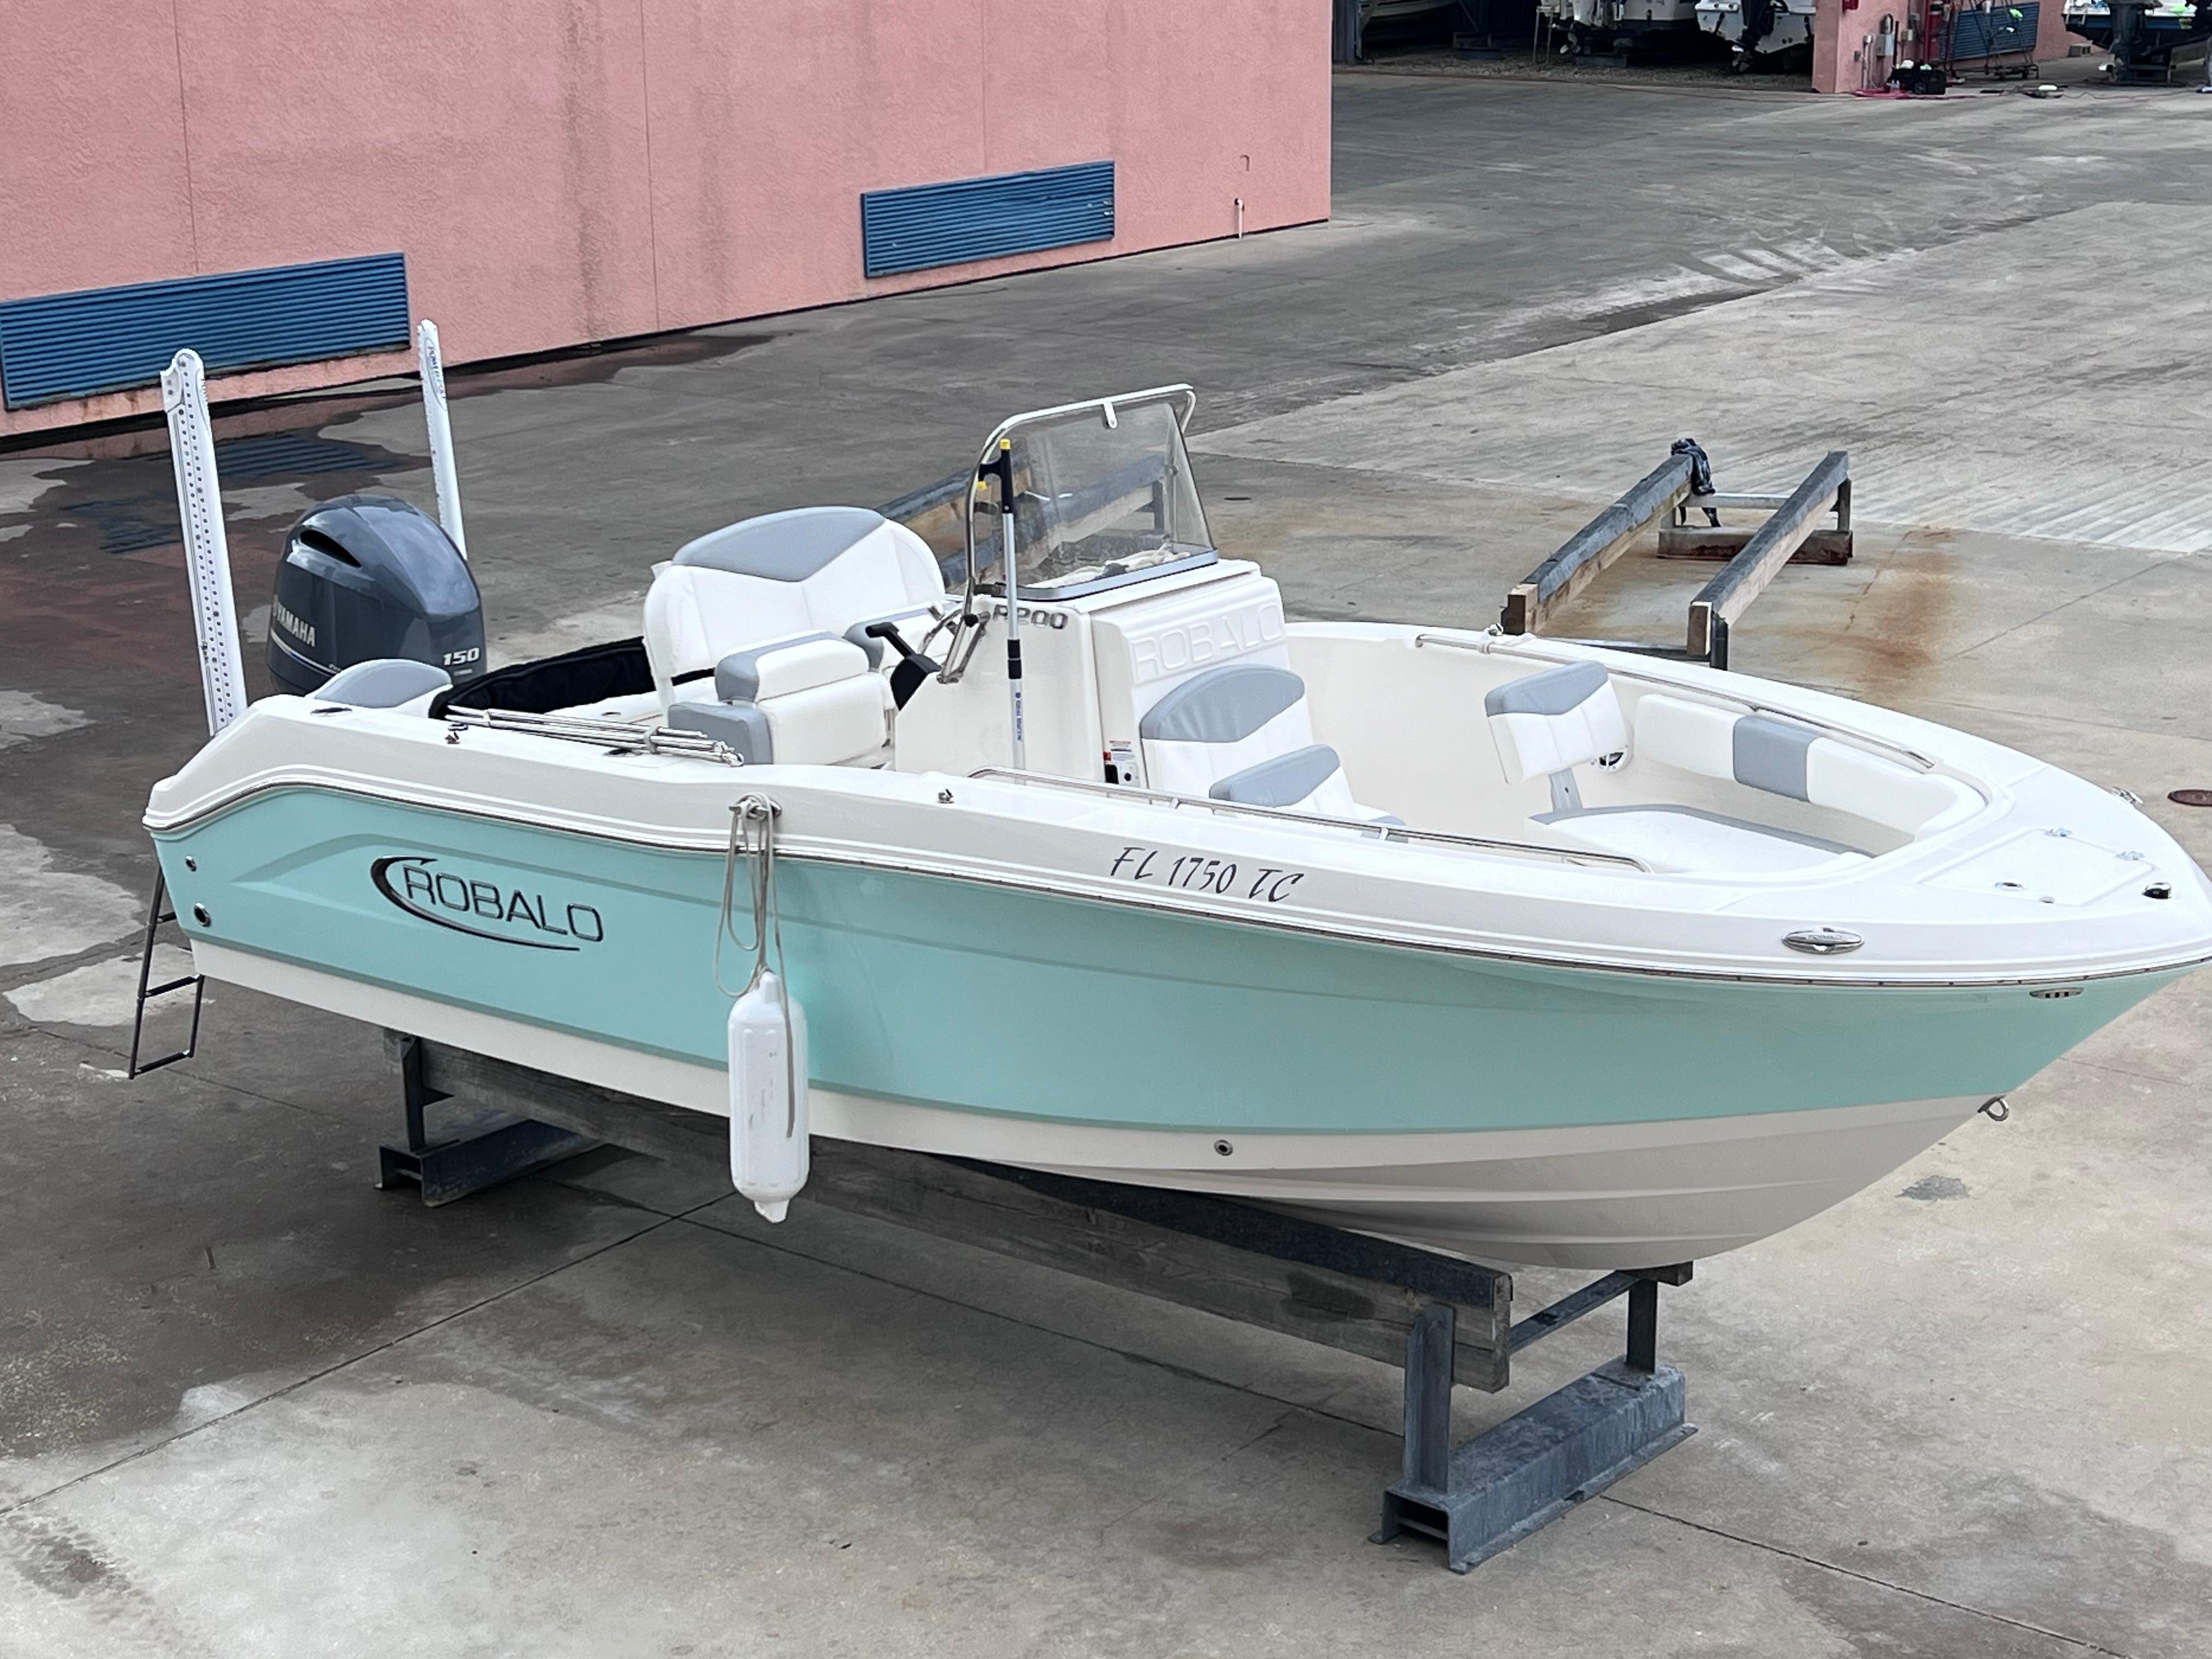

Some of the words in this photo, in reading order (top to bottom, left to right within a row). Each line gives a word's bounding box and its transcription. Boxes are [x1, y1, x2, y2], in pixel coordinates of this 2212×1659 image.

[276, 601, 316, 648] YAMAHA
[1131, 604, 1282, 680] ROBALO
[443, 647, 479, 665] 150
[1110, 847, 1159, 880] FL
[1168, 856, 1237, 894] 1750
[1249, 868, 1305, 902] TC
[403, 864, 603, 942] ROBALO
